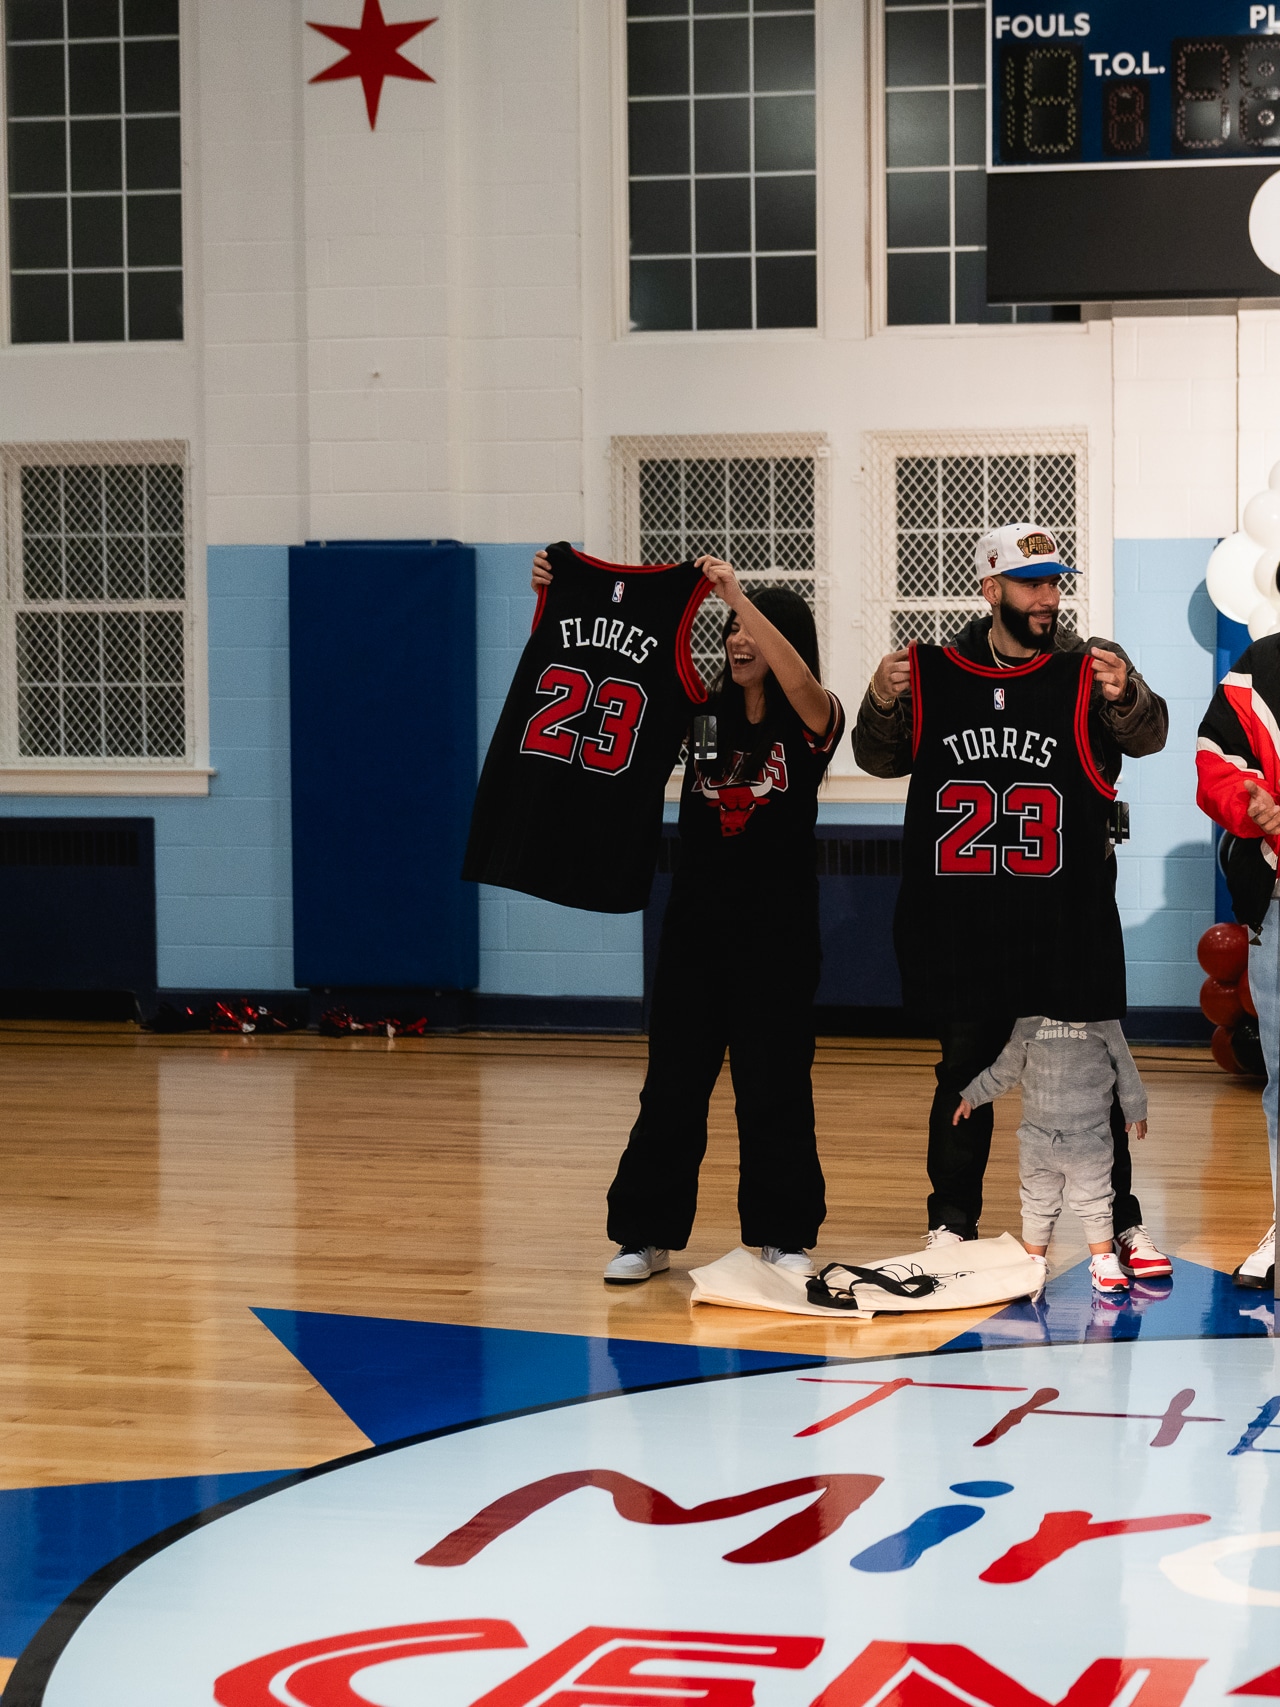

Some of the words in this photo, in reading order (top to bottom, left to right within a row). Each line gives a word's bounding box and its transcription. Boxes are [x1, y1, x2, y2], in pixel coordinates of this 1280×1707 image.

[995, 13, 1091, 39] FOULS
[1088, 51, 1166, 77] T.O.L.
[559, 616, 659, 665] FLORES
[519, 662, 649, 777] 23
[942, 726, 1058, 769] TORRES
[935, 779, 1064, 878] 23
[1035, 1026, 1088, 1040] Smiles
